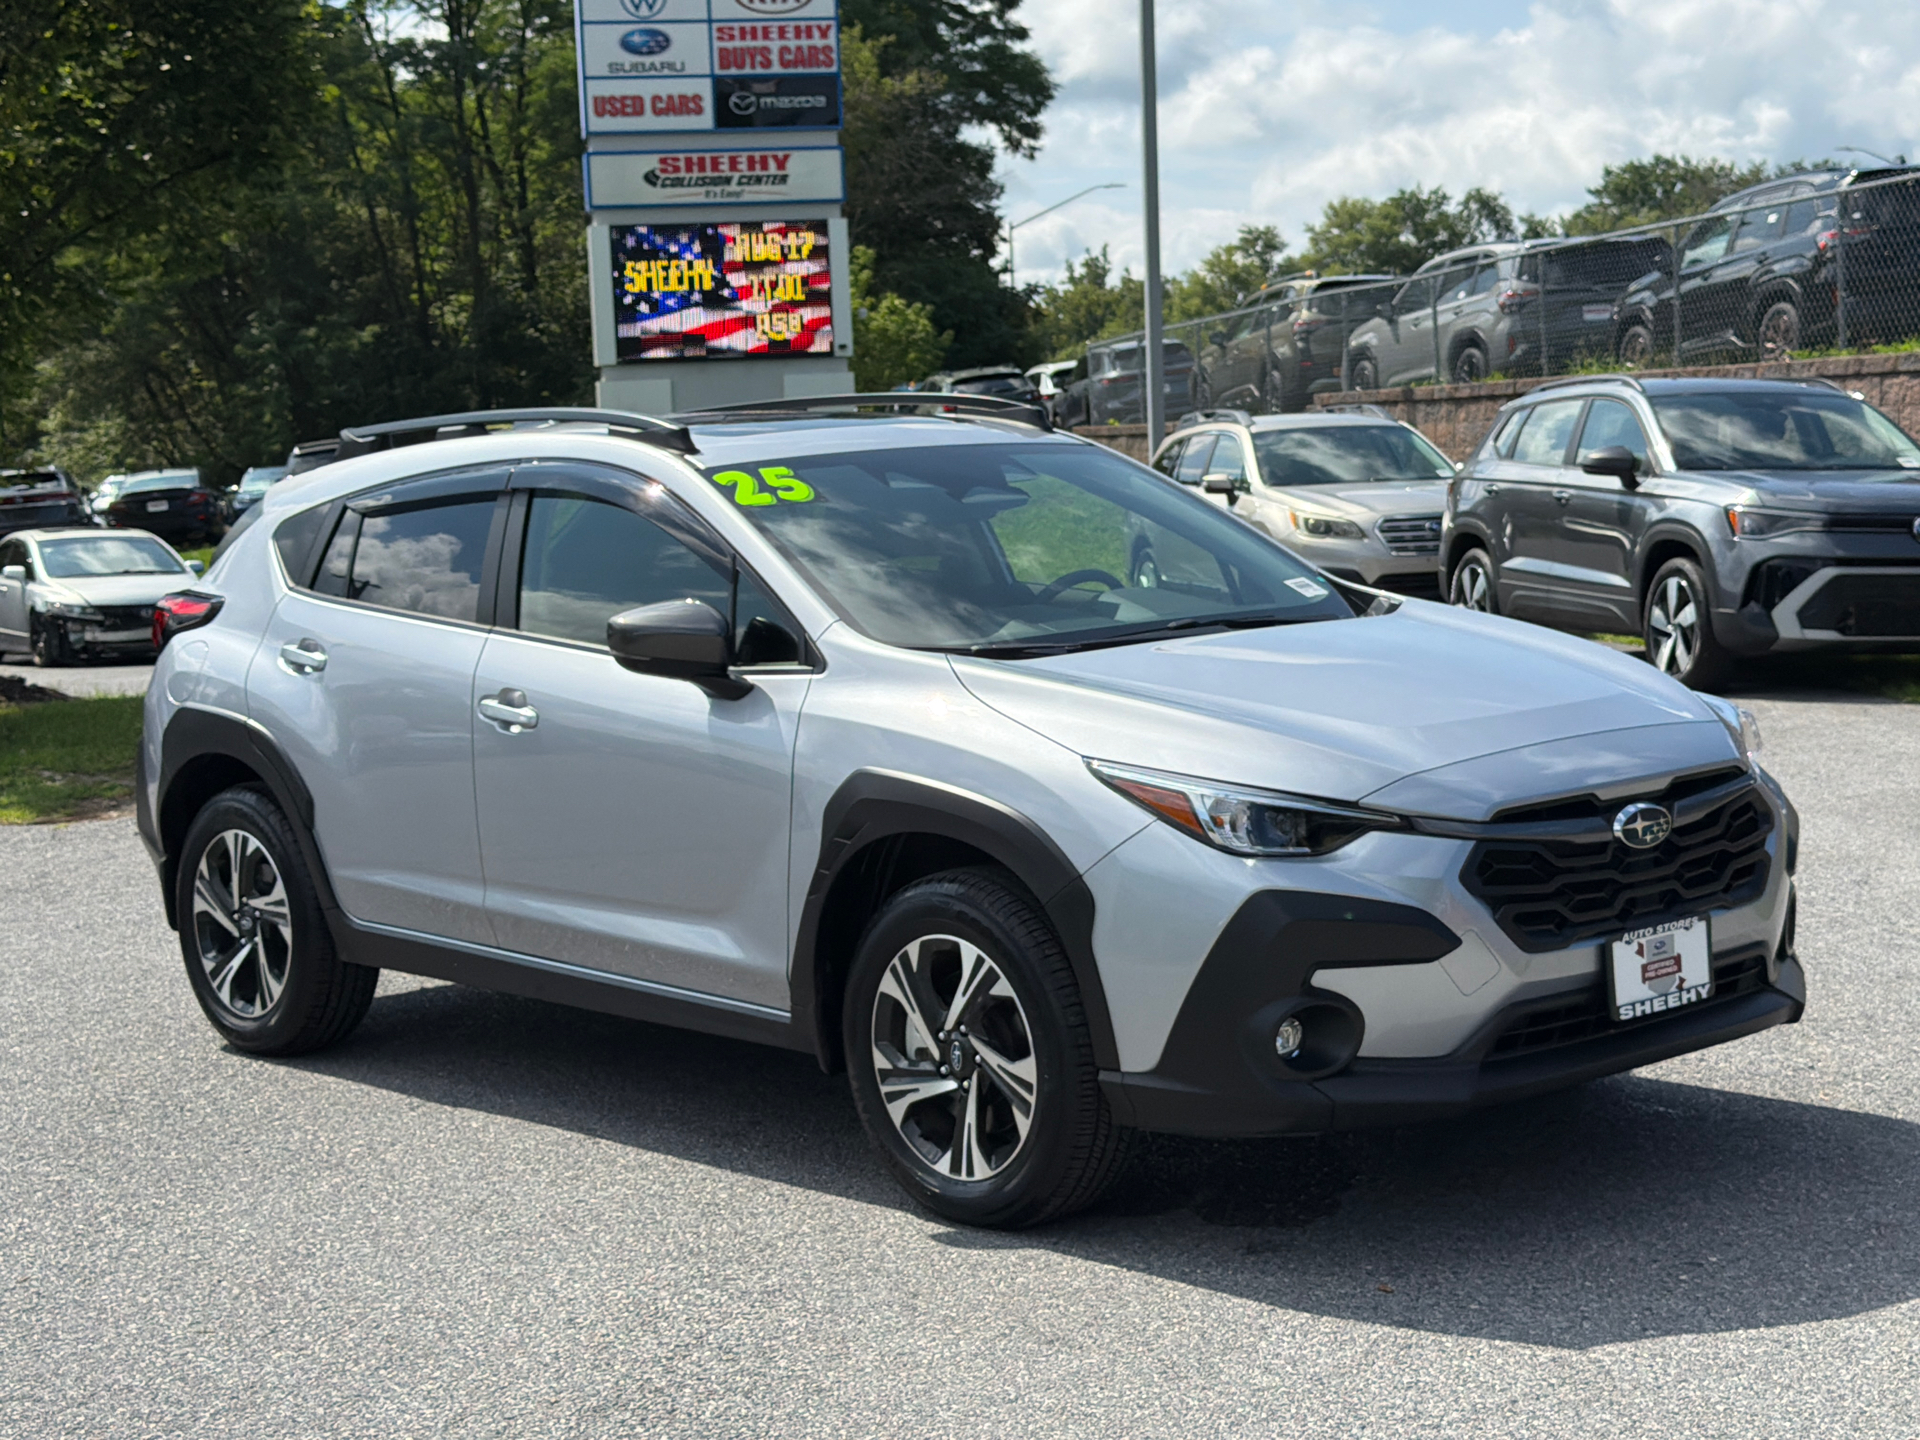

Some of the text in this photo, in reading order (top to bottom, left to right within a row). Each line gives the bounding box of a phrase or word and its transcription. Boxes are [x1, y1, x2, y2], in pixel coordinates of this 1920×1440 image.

[716, 24, 832, 42] SHEEHY
[607, 61, 686, 74] SUBARU
[718, 44, 834, 70] BUYS CARS
[593, 94, 704, 118] USED CARS
[758, 95, 827, 109] mazda
[658, 154, 791, 174] SHEEHY
[660, 174, 790, 188] COLLISION CENTER
[624, 259, 714, 293] SHEEHY
[711, 466, 816, 506] 25
[1622, 916, 1699, 942] AUTO STORES
[1619, 983, 1712, 1020] SHEEHY
